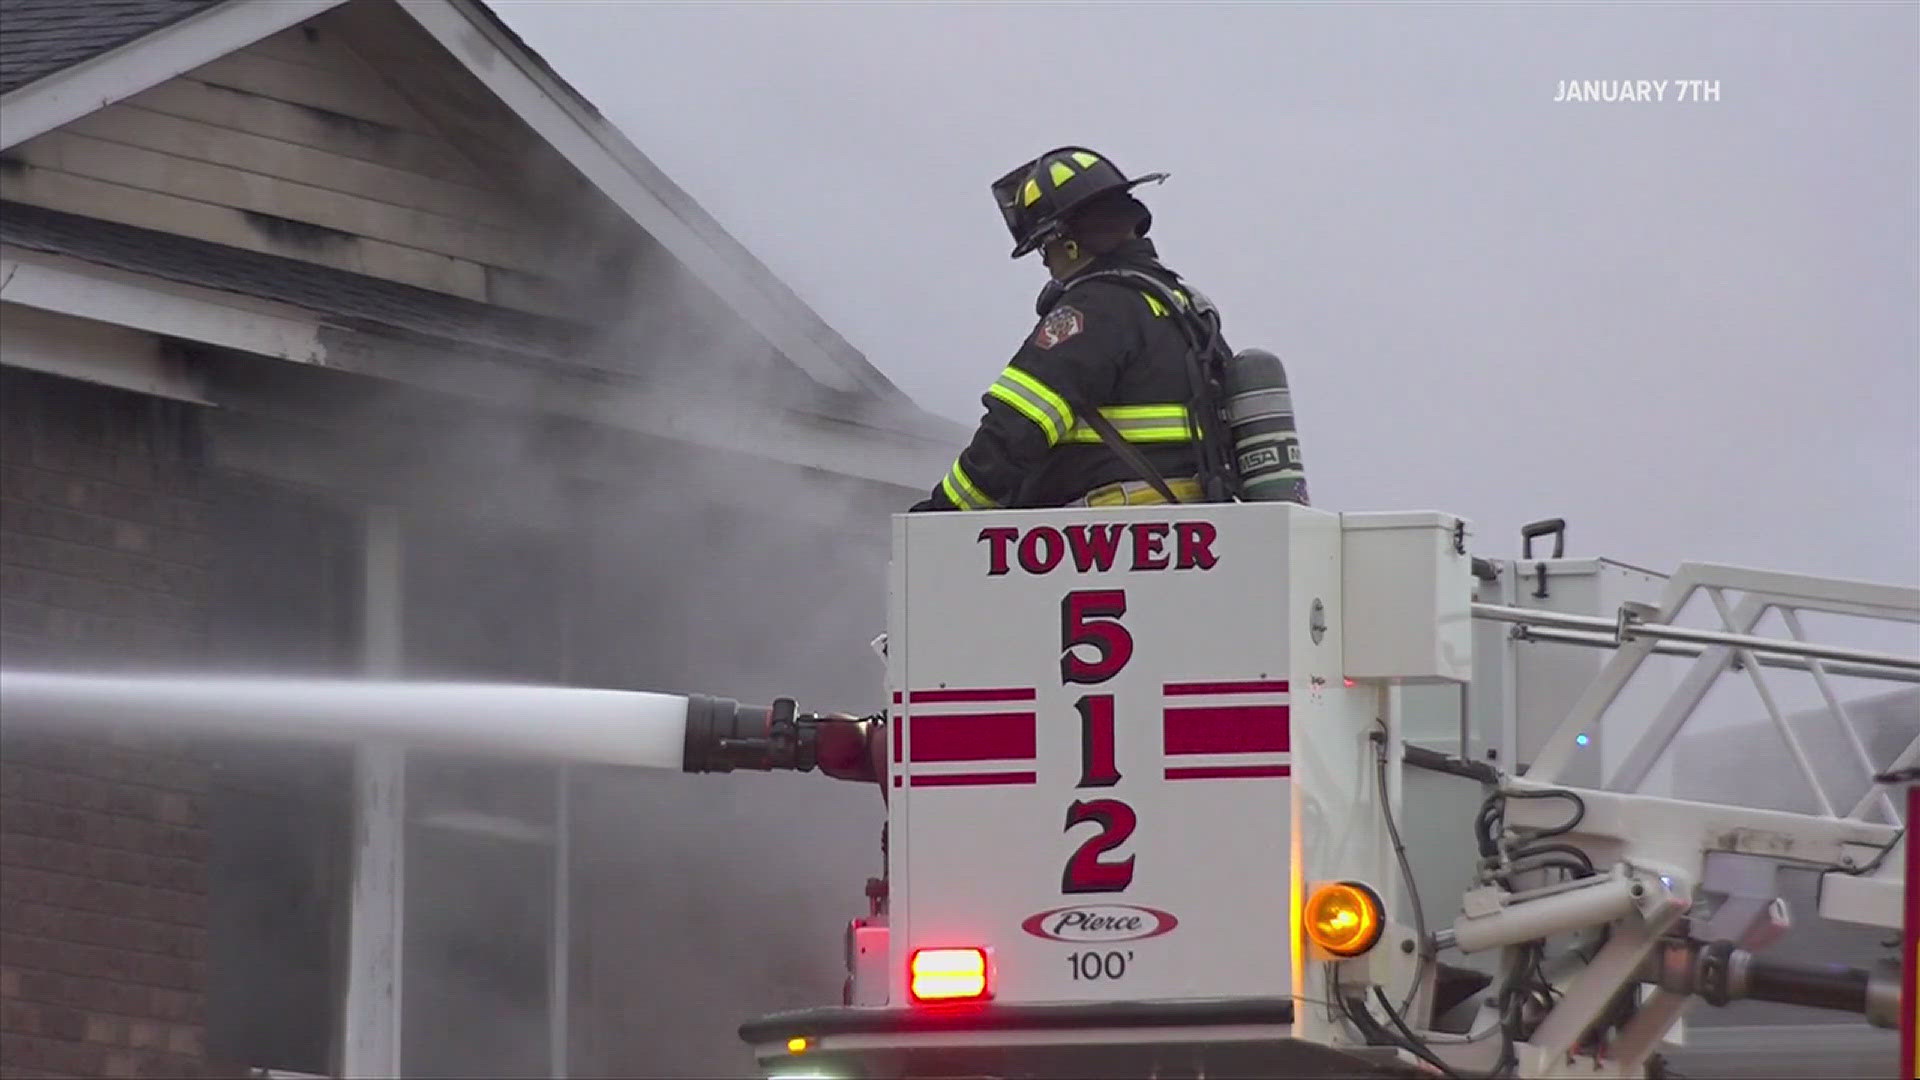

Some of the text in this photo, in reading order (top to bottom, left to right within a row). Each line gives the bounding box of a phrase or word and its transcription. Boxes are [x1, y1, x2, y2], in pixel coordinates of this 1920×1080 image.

[978, 521, 1220, 576] TOWER
[1053, 910, 1142, 935] Pierce
[1067, 951, 1134, 981] 100'
